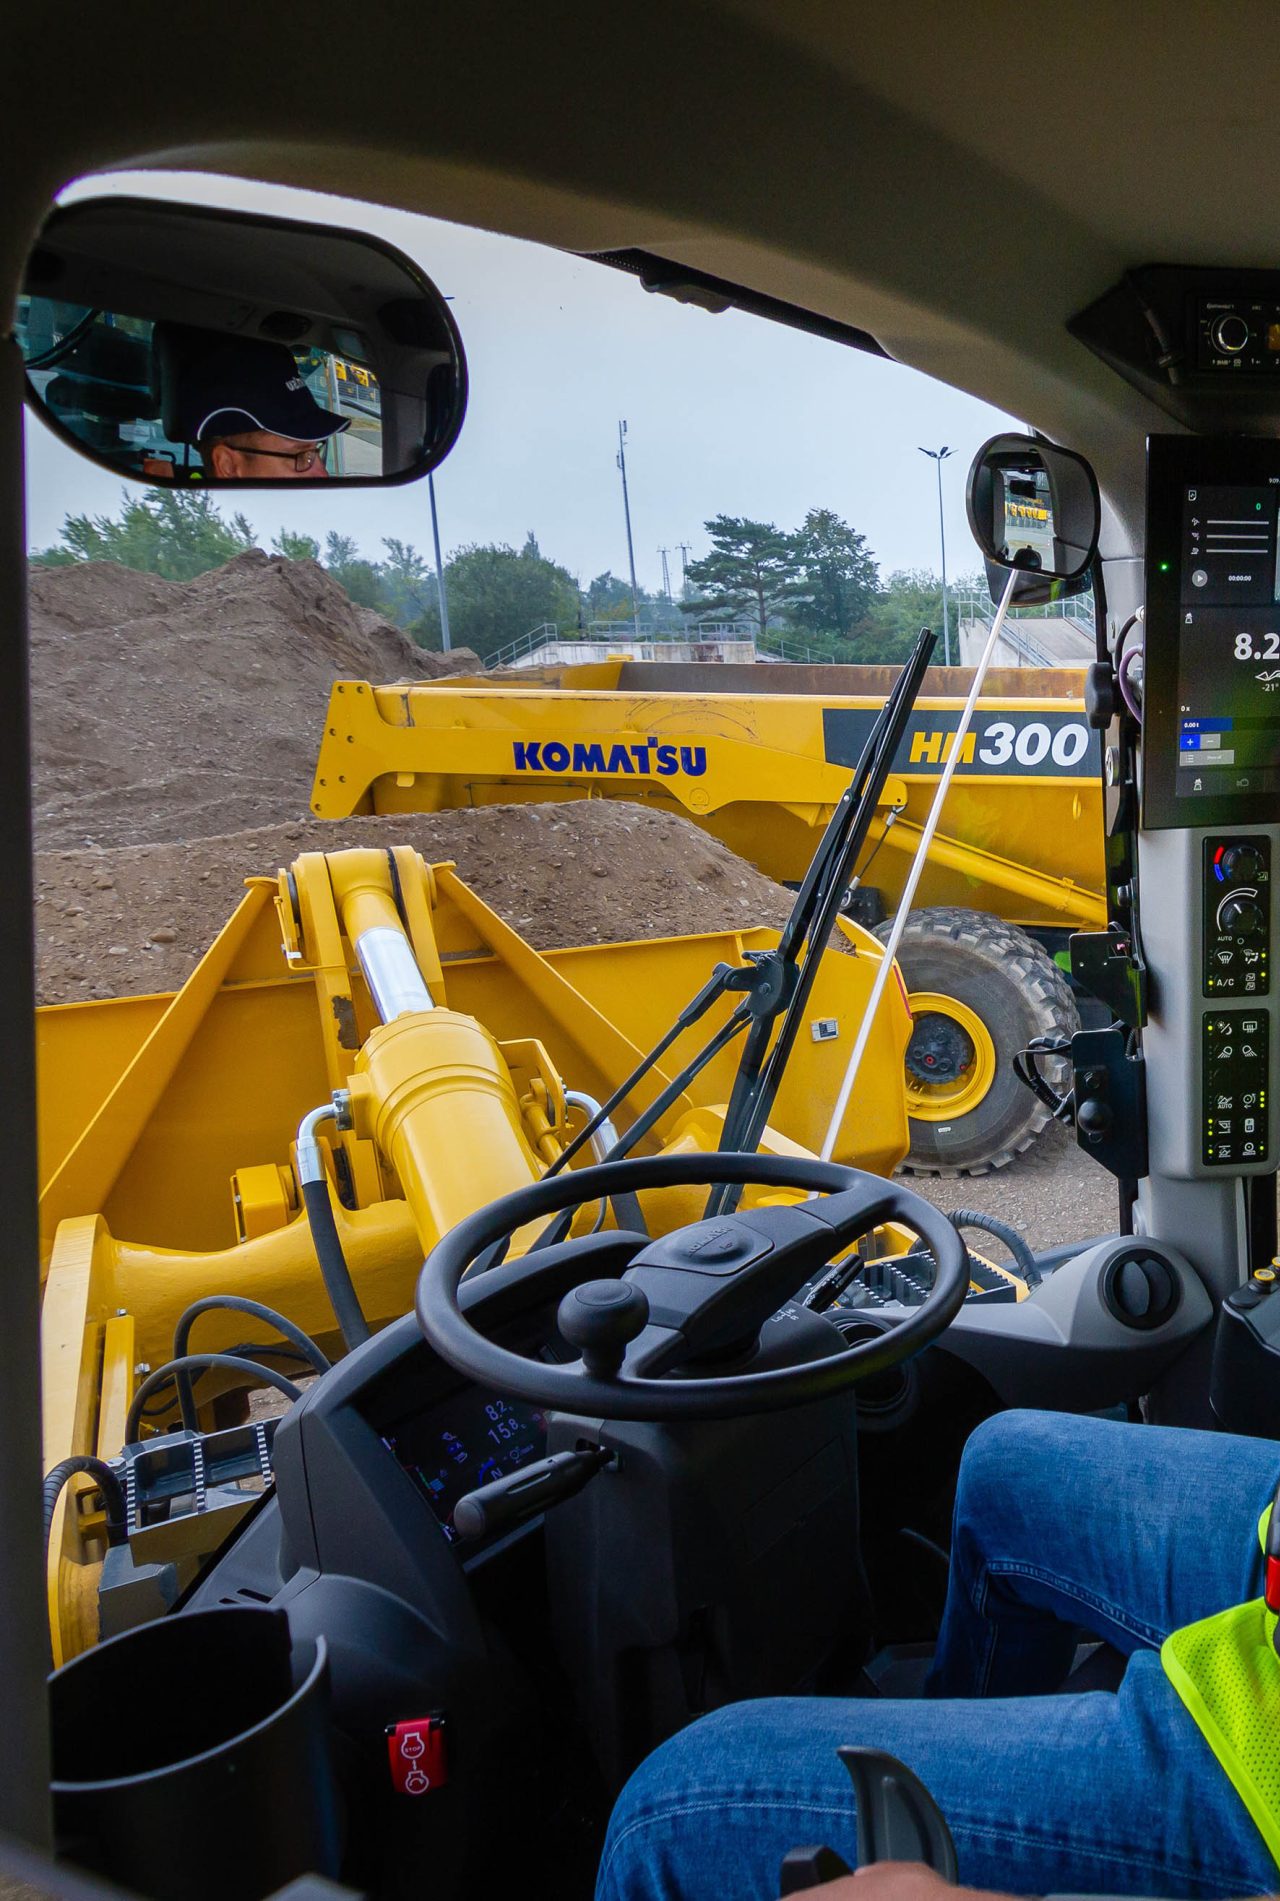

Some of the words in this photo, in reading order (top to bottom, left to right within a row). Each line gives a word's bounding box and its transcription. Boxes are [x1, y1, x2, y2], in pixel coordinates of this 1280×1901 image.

[1227, 574, 1252, 582] 00:00:00
[512, 736, 708, 777] KOMATSU
[1216, 978, 1235, 987] A/C
[1217, 1102, 1233, 1110] AUTO
